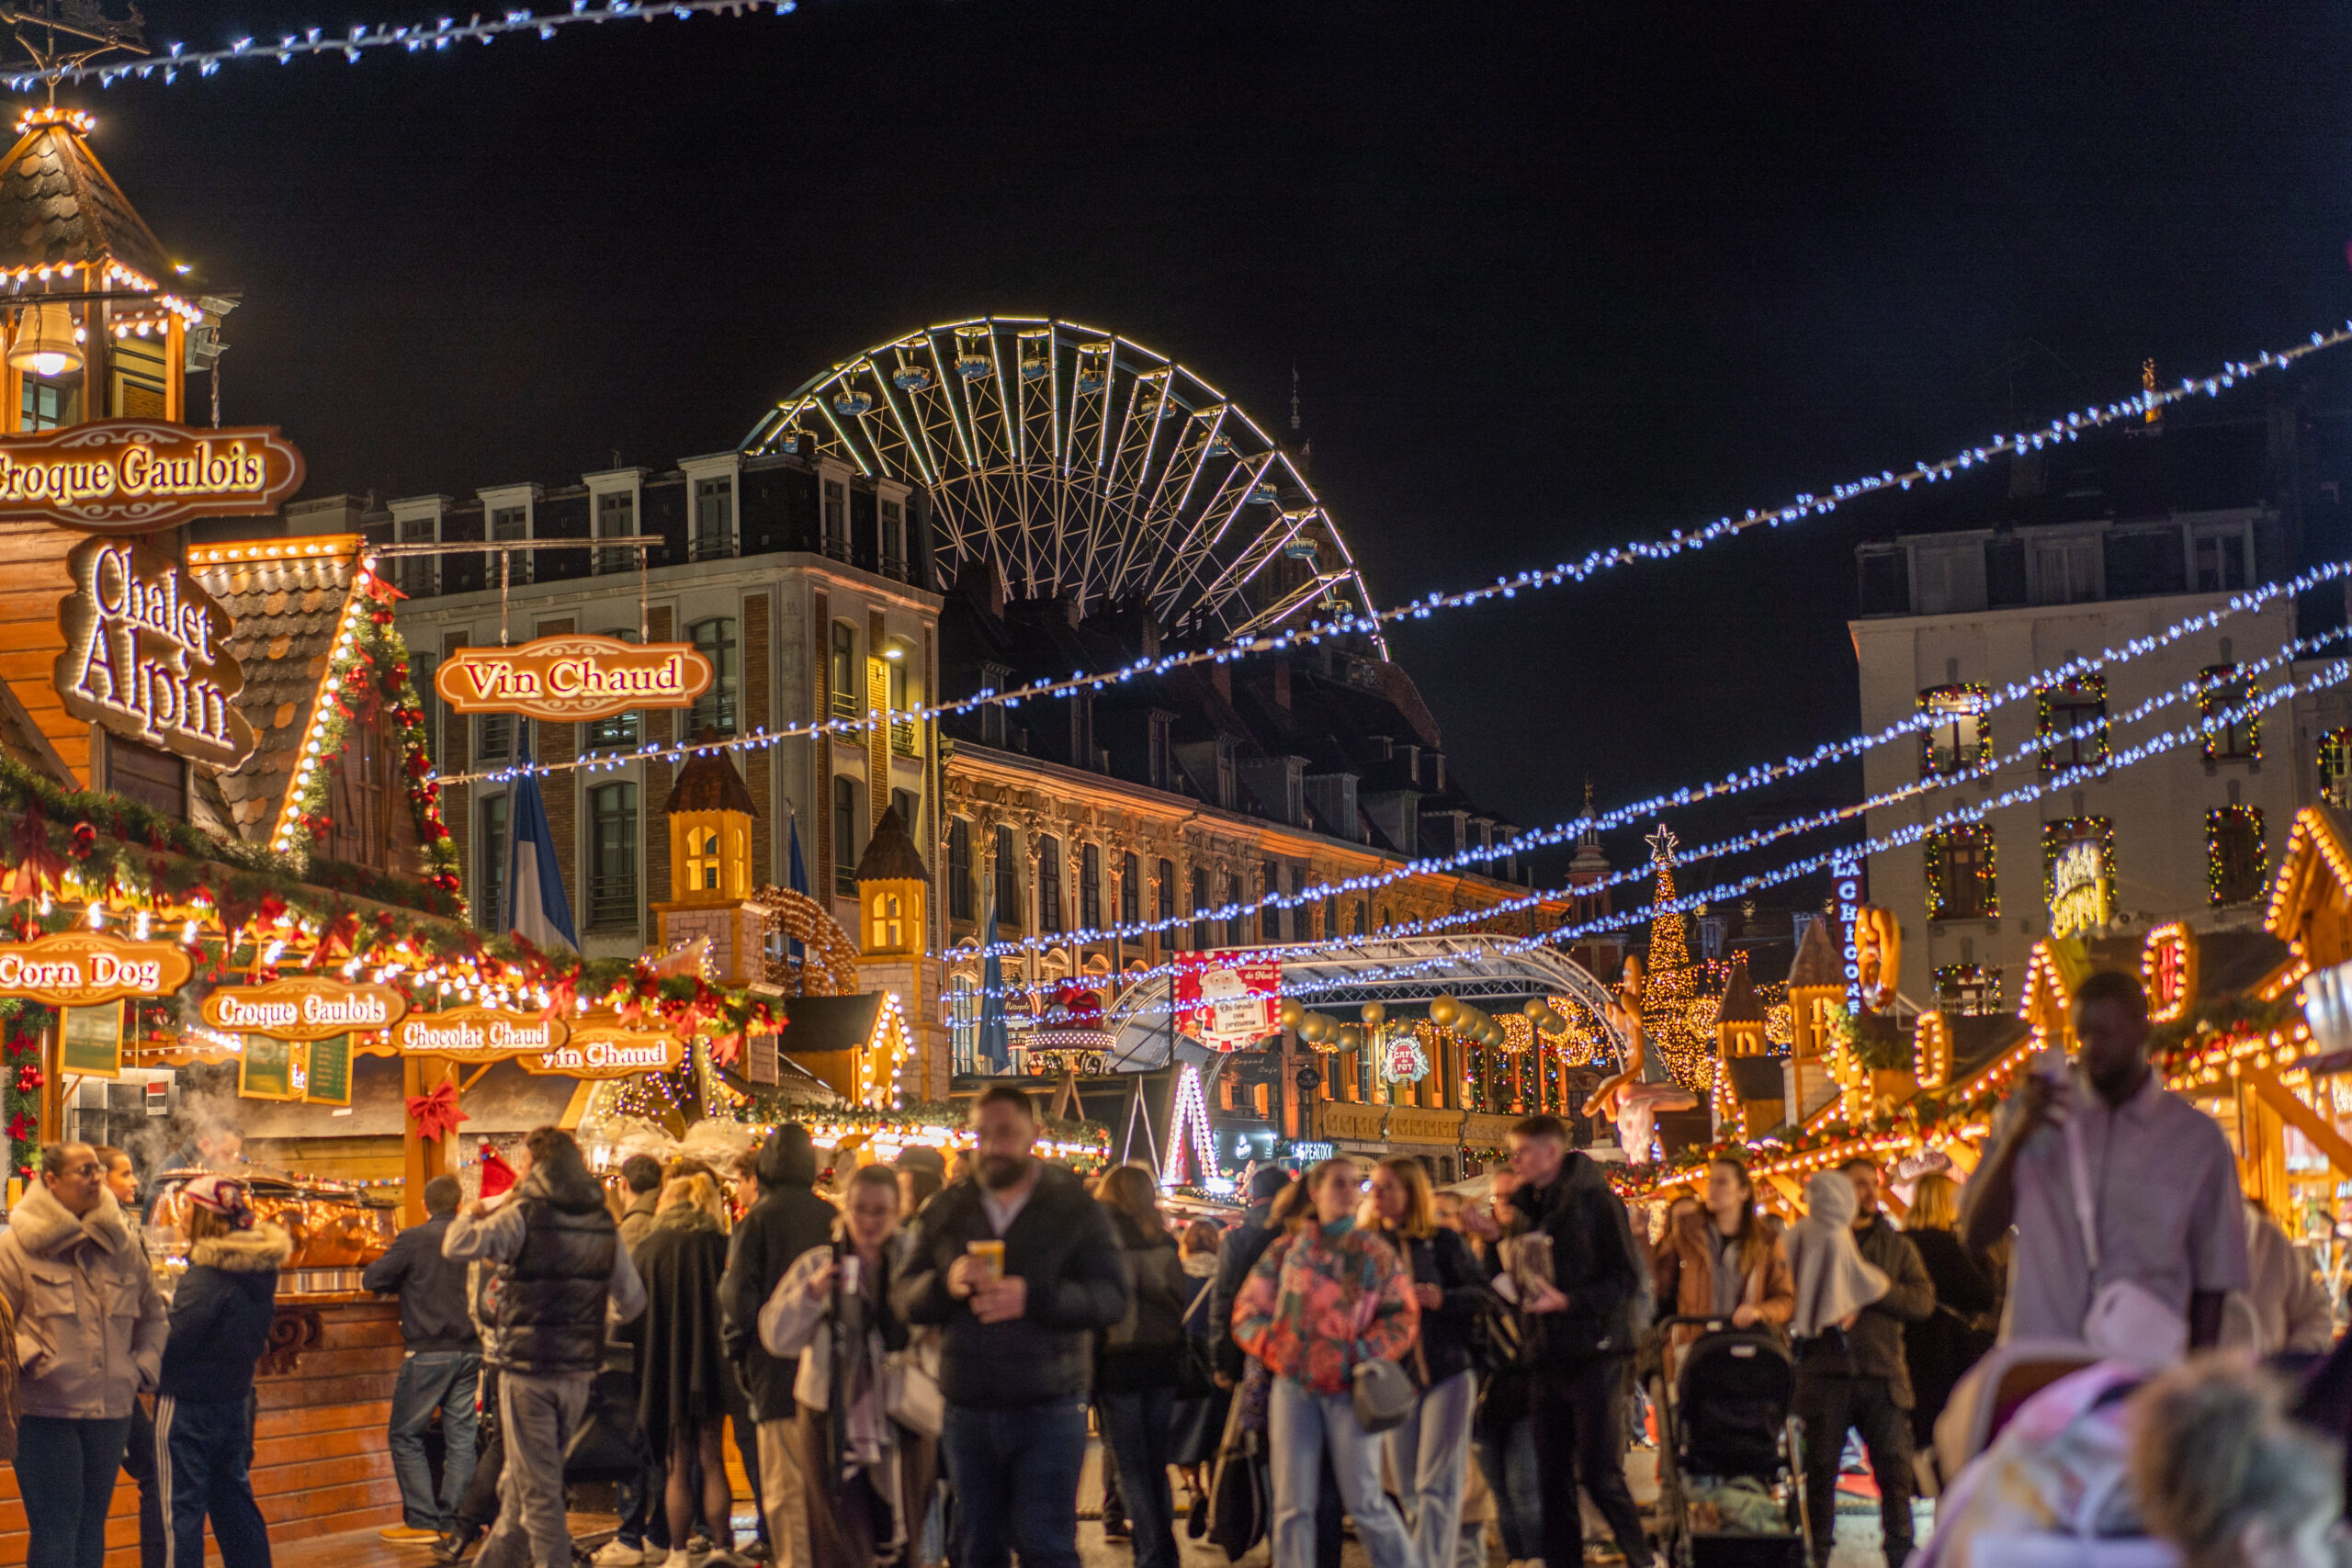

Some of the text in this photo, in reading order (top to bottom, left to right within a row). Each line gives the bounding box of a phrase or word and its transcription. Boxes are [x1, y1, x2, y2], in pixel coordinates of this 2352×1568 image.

[119, 440, 266, 497] Gaulois
[92, 542, 216, 666] Chalet
[74, 614, 236, 750] Alpin
[463, 653, 684, 700] Vin Chaud
[0, 952, 160, 992] Corn Dog
[217, 992, 386, 1030] Croque Gaulois
[1219, 1003, 1233, 1012] On
[402, 1020, 549, 1050] Chocolat Chaud
[583, 1039, 668, 1068] Chaud
